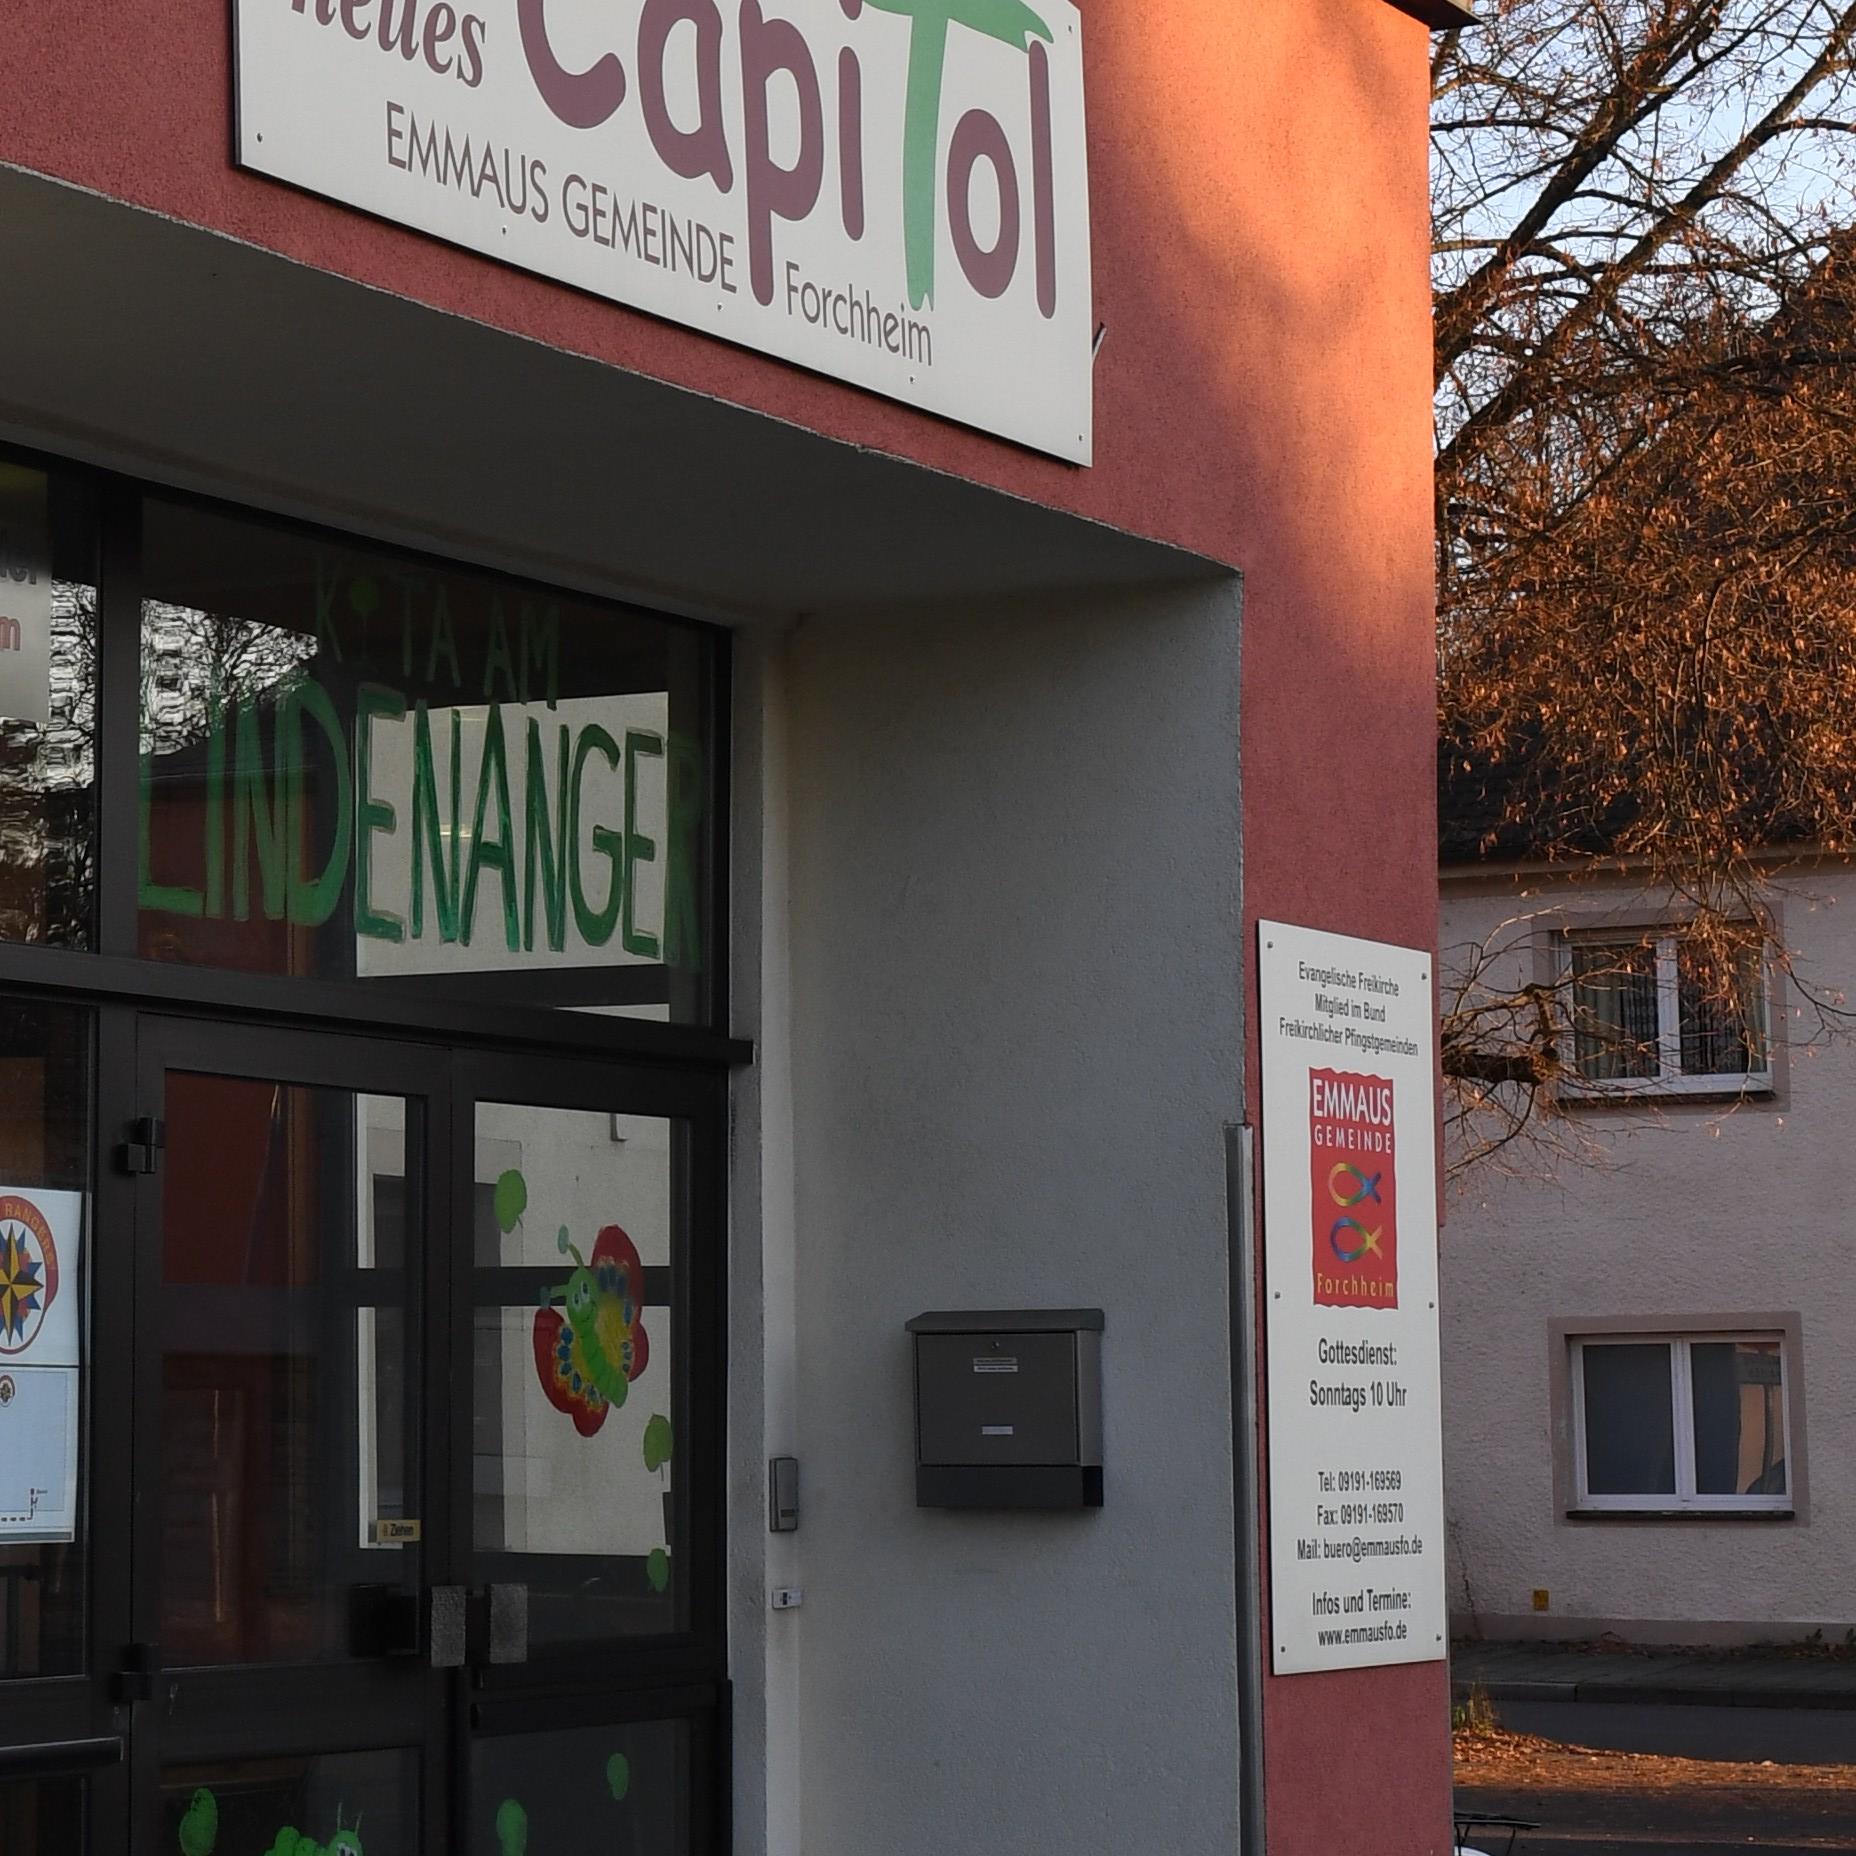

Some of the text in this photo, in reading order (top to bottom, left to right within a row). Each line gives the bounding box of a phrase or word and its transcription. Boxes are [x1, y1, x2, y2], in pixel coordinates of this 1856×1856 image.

[385, 100, 933, 367] EMMAUS GEMEINDE Forchheim
[1298, 960, 1399, 998] Evangelische Freikirche
[1314, 992, 1386, 1023] Mitglied im Bund
[1279, 1016, 1419, 1057] Freikirchlicher Pfingstgemeinden
[1313, 1077, 1392, 1127] EMMAUS
[1314, 1125, 1392, 1154] GEMEINDE
[1316, 1272, 1395, 1299] Forchheim
[1318, 1337, 1398, 1367] Gottesdienst:
[1309, 1379, 1408, 1414] Sonntags 10 Uhr
[1318, 1470, 1402, 1492] Tel: 09191-169569
[1317, 1502, 1404, 1526] Fax: 09191-169570
[1297, 1534, 1424, 1563] Mail: buero@emmausfo.de
[1312, 1587, 1412, 1616] Infos und Termine:
[1318, 1619, 1408, 1646] www.emmausfo.de
